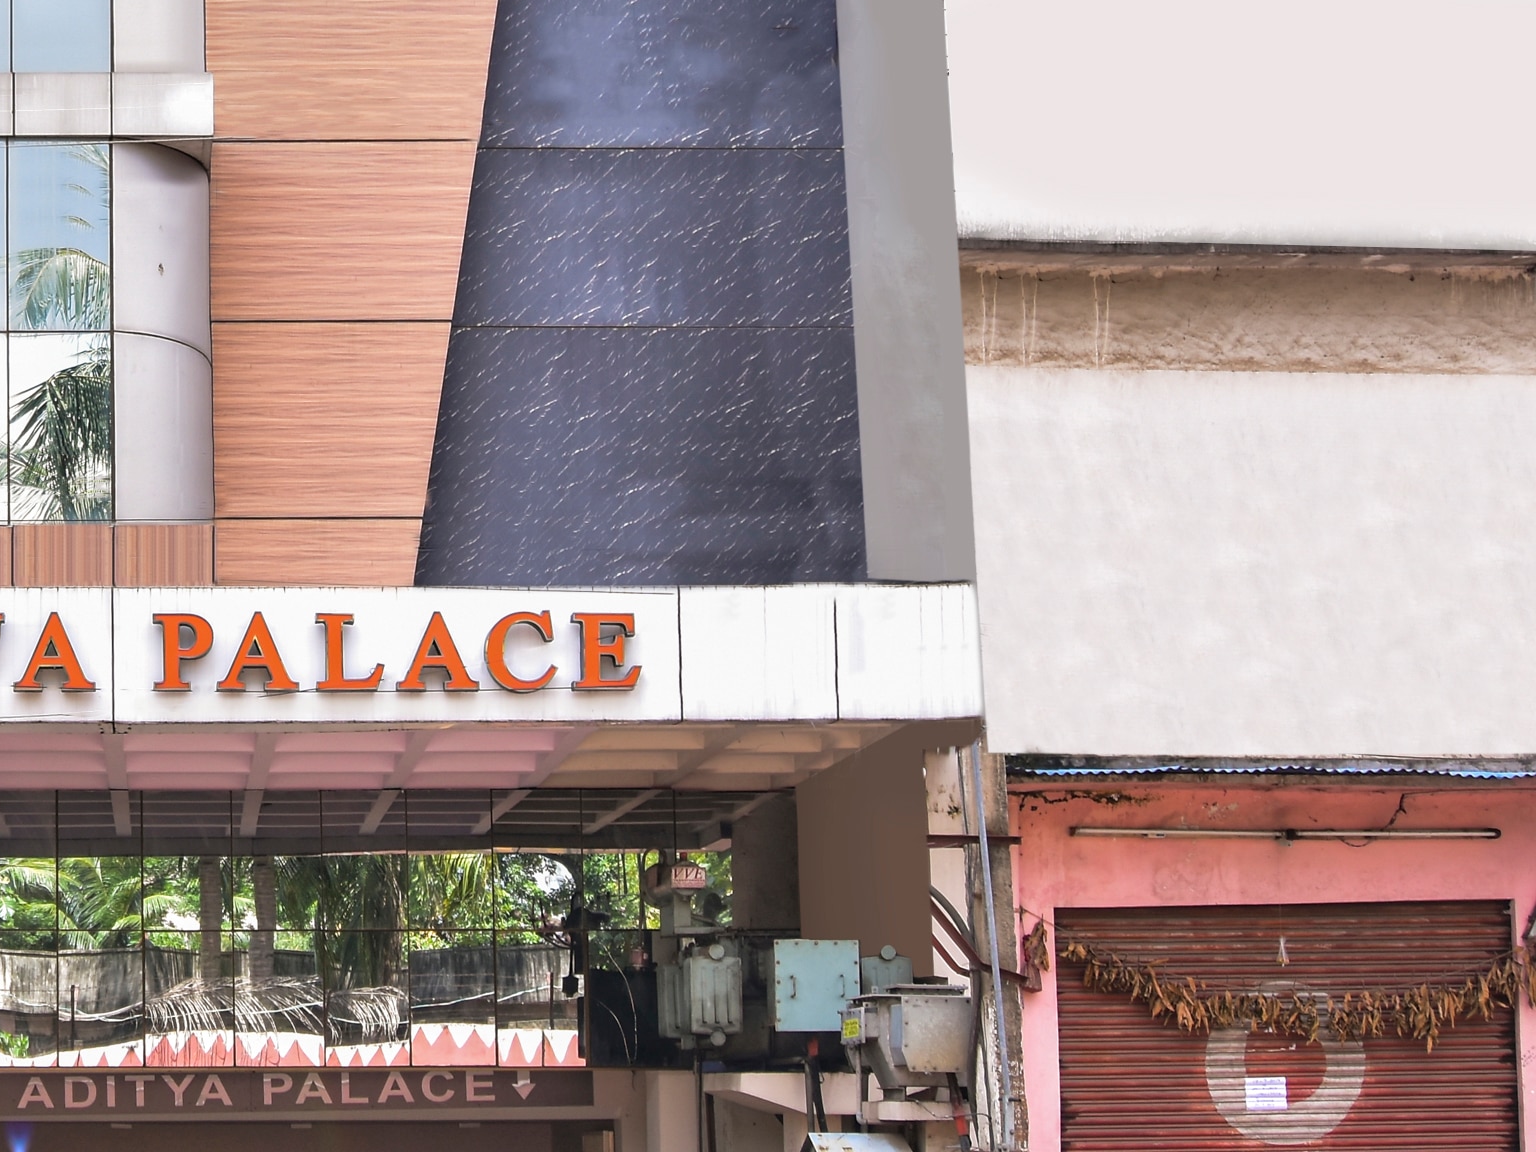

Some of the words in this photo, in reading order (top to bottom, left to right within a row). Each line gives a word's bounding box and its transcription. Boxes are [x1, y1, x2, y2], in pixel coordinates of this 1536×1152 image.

[152, 610, 642, 693] PALACE
[17, 1074, 233, 1109] ADITYA
[264, 1070, 496, 1106] PALACE
